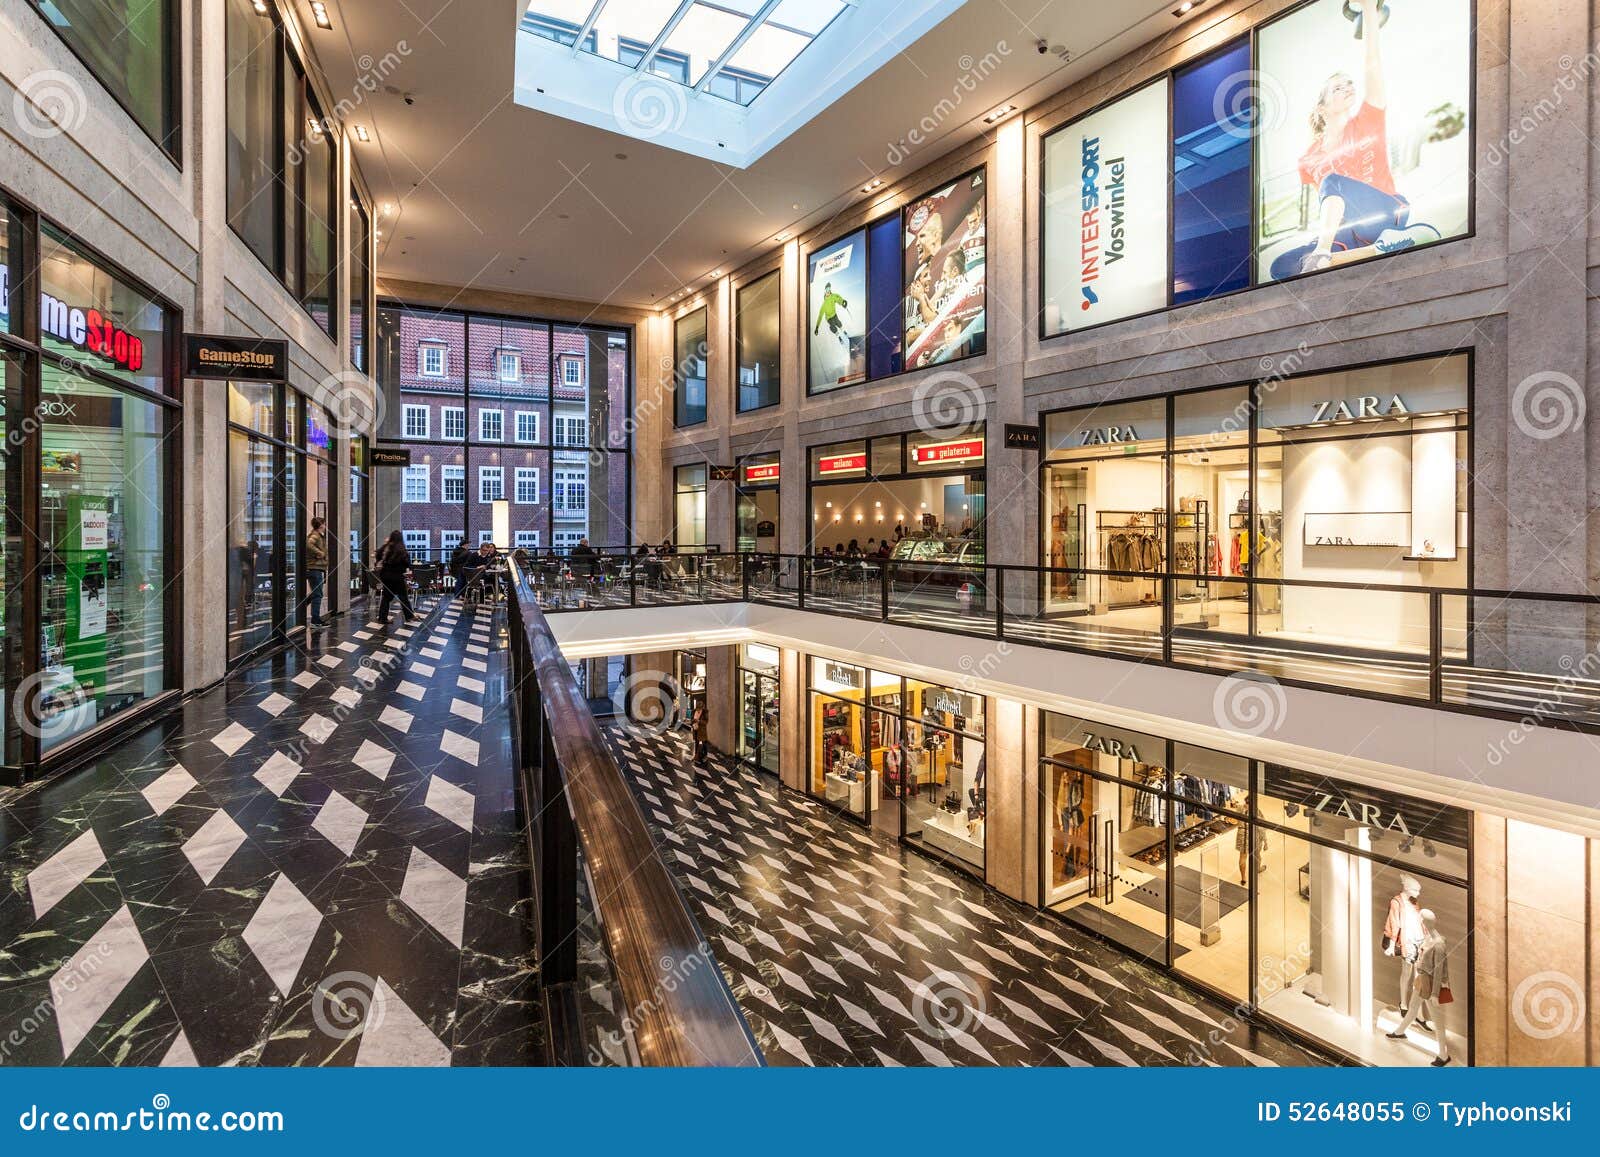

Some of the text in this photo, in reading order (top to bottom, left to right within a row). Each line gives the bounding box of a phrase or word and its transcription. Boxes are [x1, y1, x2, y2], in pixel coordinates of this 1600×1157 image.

[1081, 136, 1100, 283] INTERSPORT
[1105, 156, 1125, 266] Voswinkel
[199, 347, 274, 365] GameStop
[40, 402, 77, 417] BOX
[1312, 393, 1409, 424] ZARA
[1008, 432, 1037, 442] ZARA
[1080, 424, 1140, 446] ZARA
[833, 458, 853, 468] milano
[939, 446, 971, 461] gelateria
[1315, 536, 1355, 546] ZARA
[1081, 731, 1143, 764] ZARA
[1315, 791, 1413, 837] ZARA
